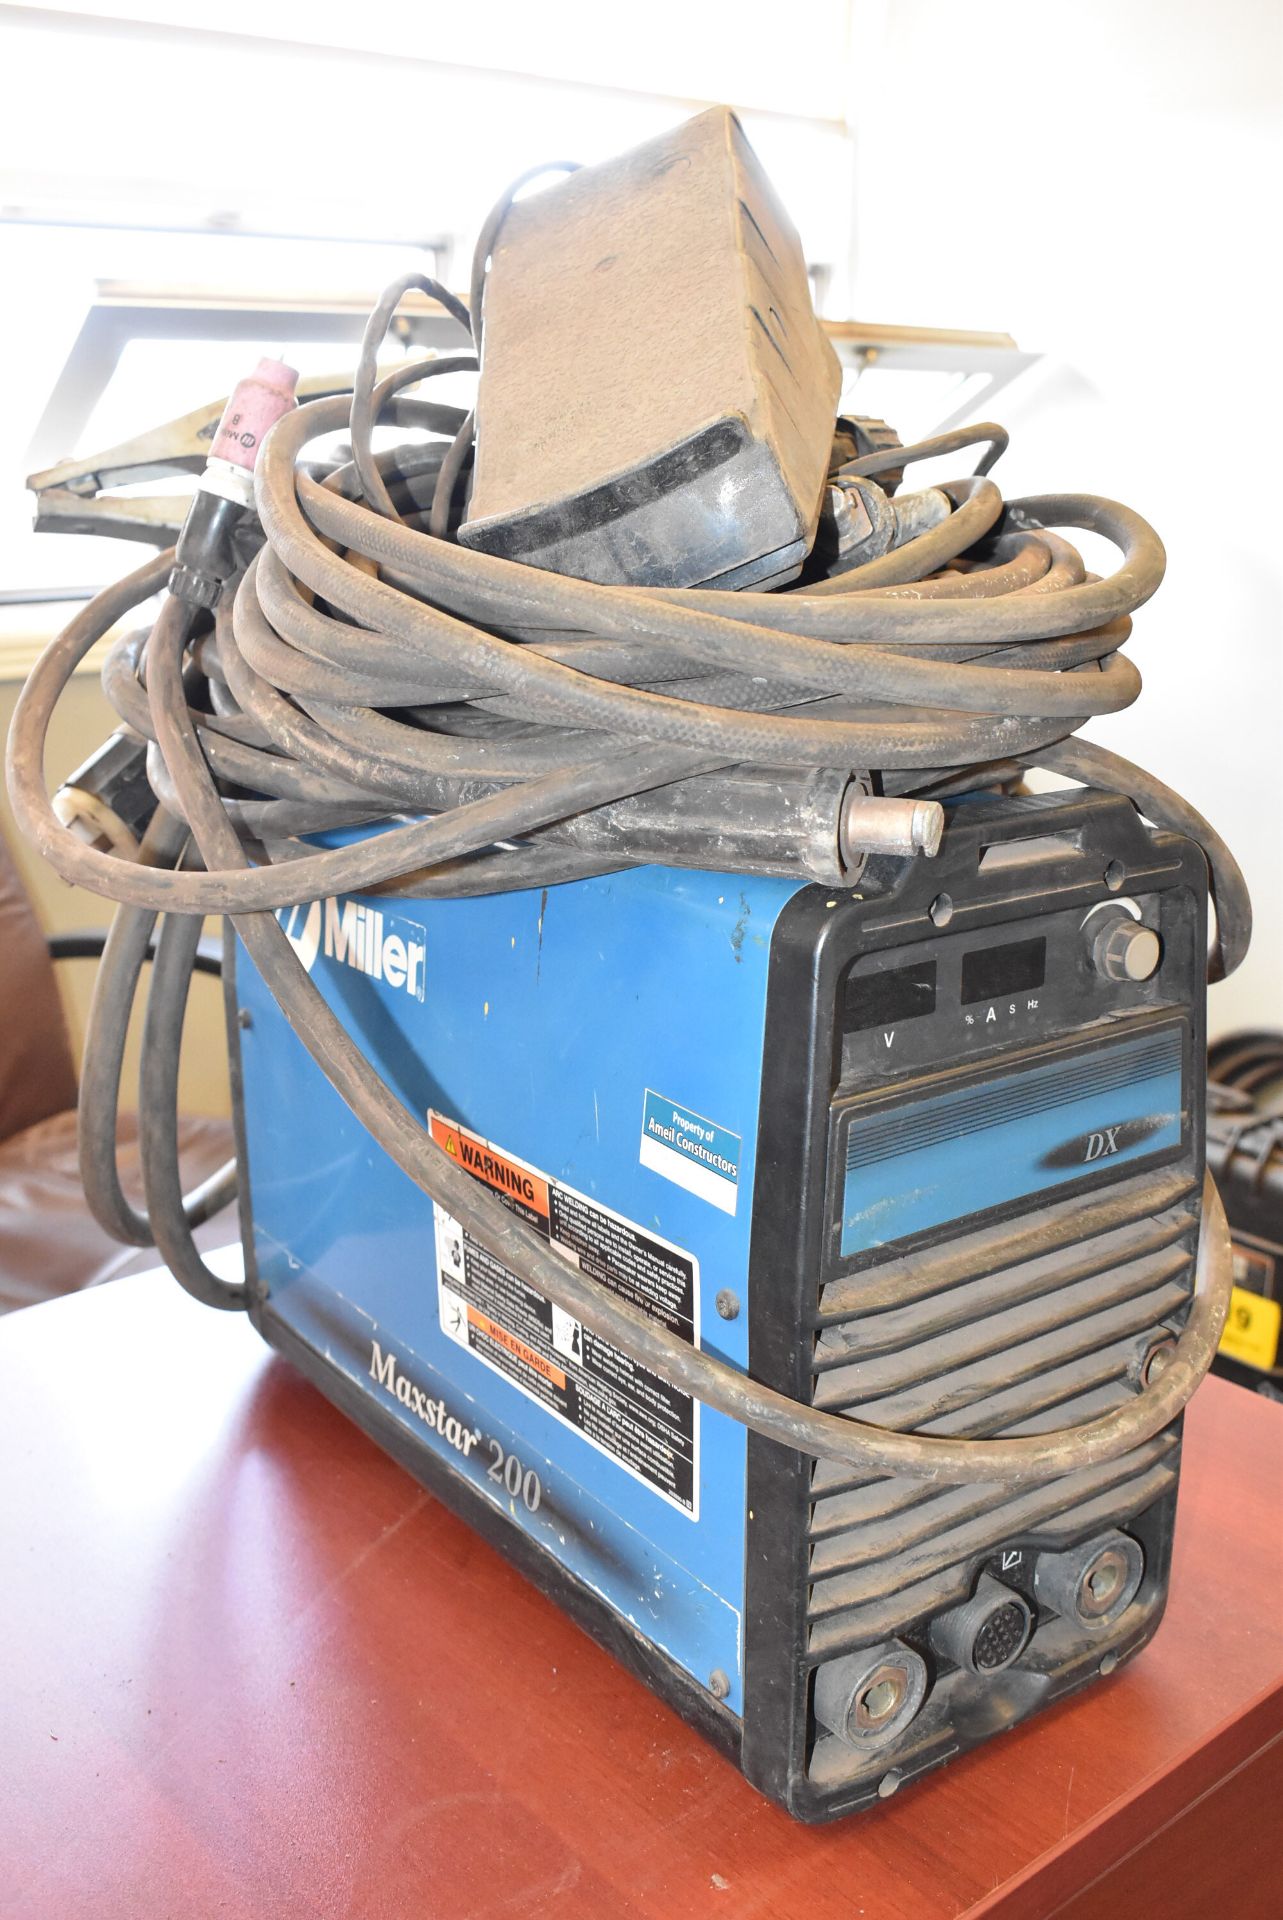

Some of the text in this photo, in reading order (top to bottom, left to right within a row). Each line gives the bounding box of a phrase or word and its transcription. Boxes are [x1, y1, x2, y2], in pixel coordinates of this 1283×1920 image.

[325, 896, 424, 996] Miller
[965, 999, 1039, 1025] % A S Hz
[884, 1031, 895, 1048] V
[648, 1116, 737, 1177] Ameil Constructors
[672, 1110, 715, 1143] Property of
[1084, 1126, 1121, 1162] DX
[460, 1140, 535, 1203] WARNING
[552, 1187, 563, 1200] ARC
[564, 1194, 588, 1215] WELDING
[589, 1208, 598, 1221] can
[600, 1214, 605, 1225] be
[581, 1259, 606, 1282] WELDING
[607, 1275, 616, 1289] can
[617, 1282, 633, 1299] cause
[644, 1298, 650, 1309] or
[489, 1324, 552, 1376] MISE EN GARDE
[368, 1340, 478, 1457] Maxstar
[487, 1438, 541, 1512] 200
